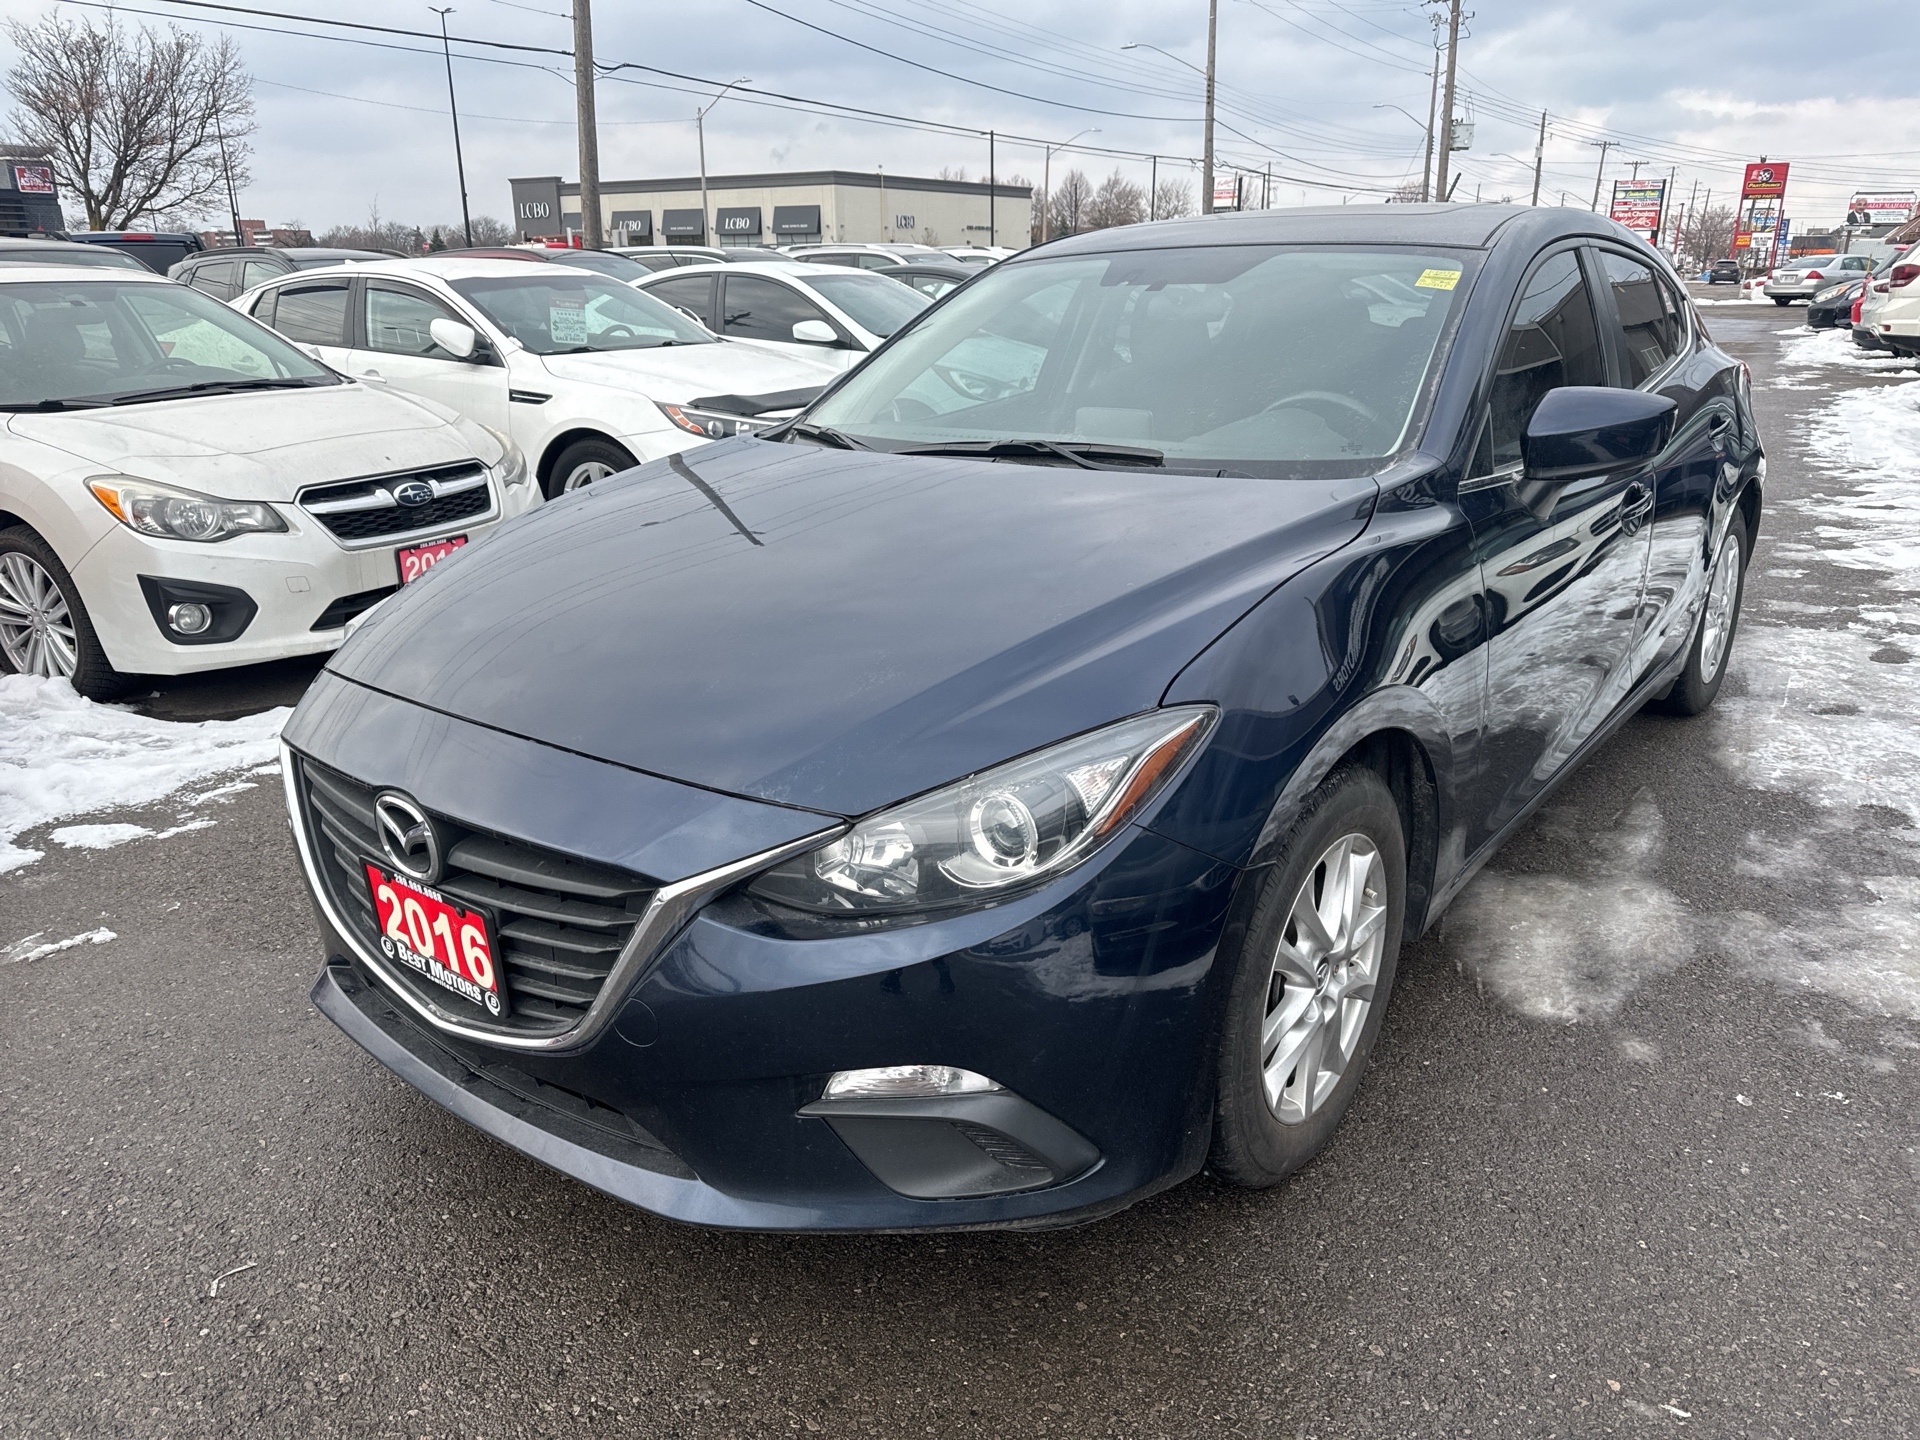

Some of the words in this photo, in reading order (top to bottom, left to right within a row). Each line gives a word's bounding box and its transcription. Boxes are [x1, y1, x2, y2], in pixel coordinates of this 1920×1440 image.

[520, 202, 549, 219] LCBO
[619, 220, 641, 231] LCBO
[724, 218, 749, 230] LCBO
[553, 320, 559, 331] $
[406, 546, 458, 582] 201
[378, 884, 494, 988] 2016
